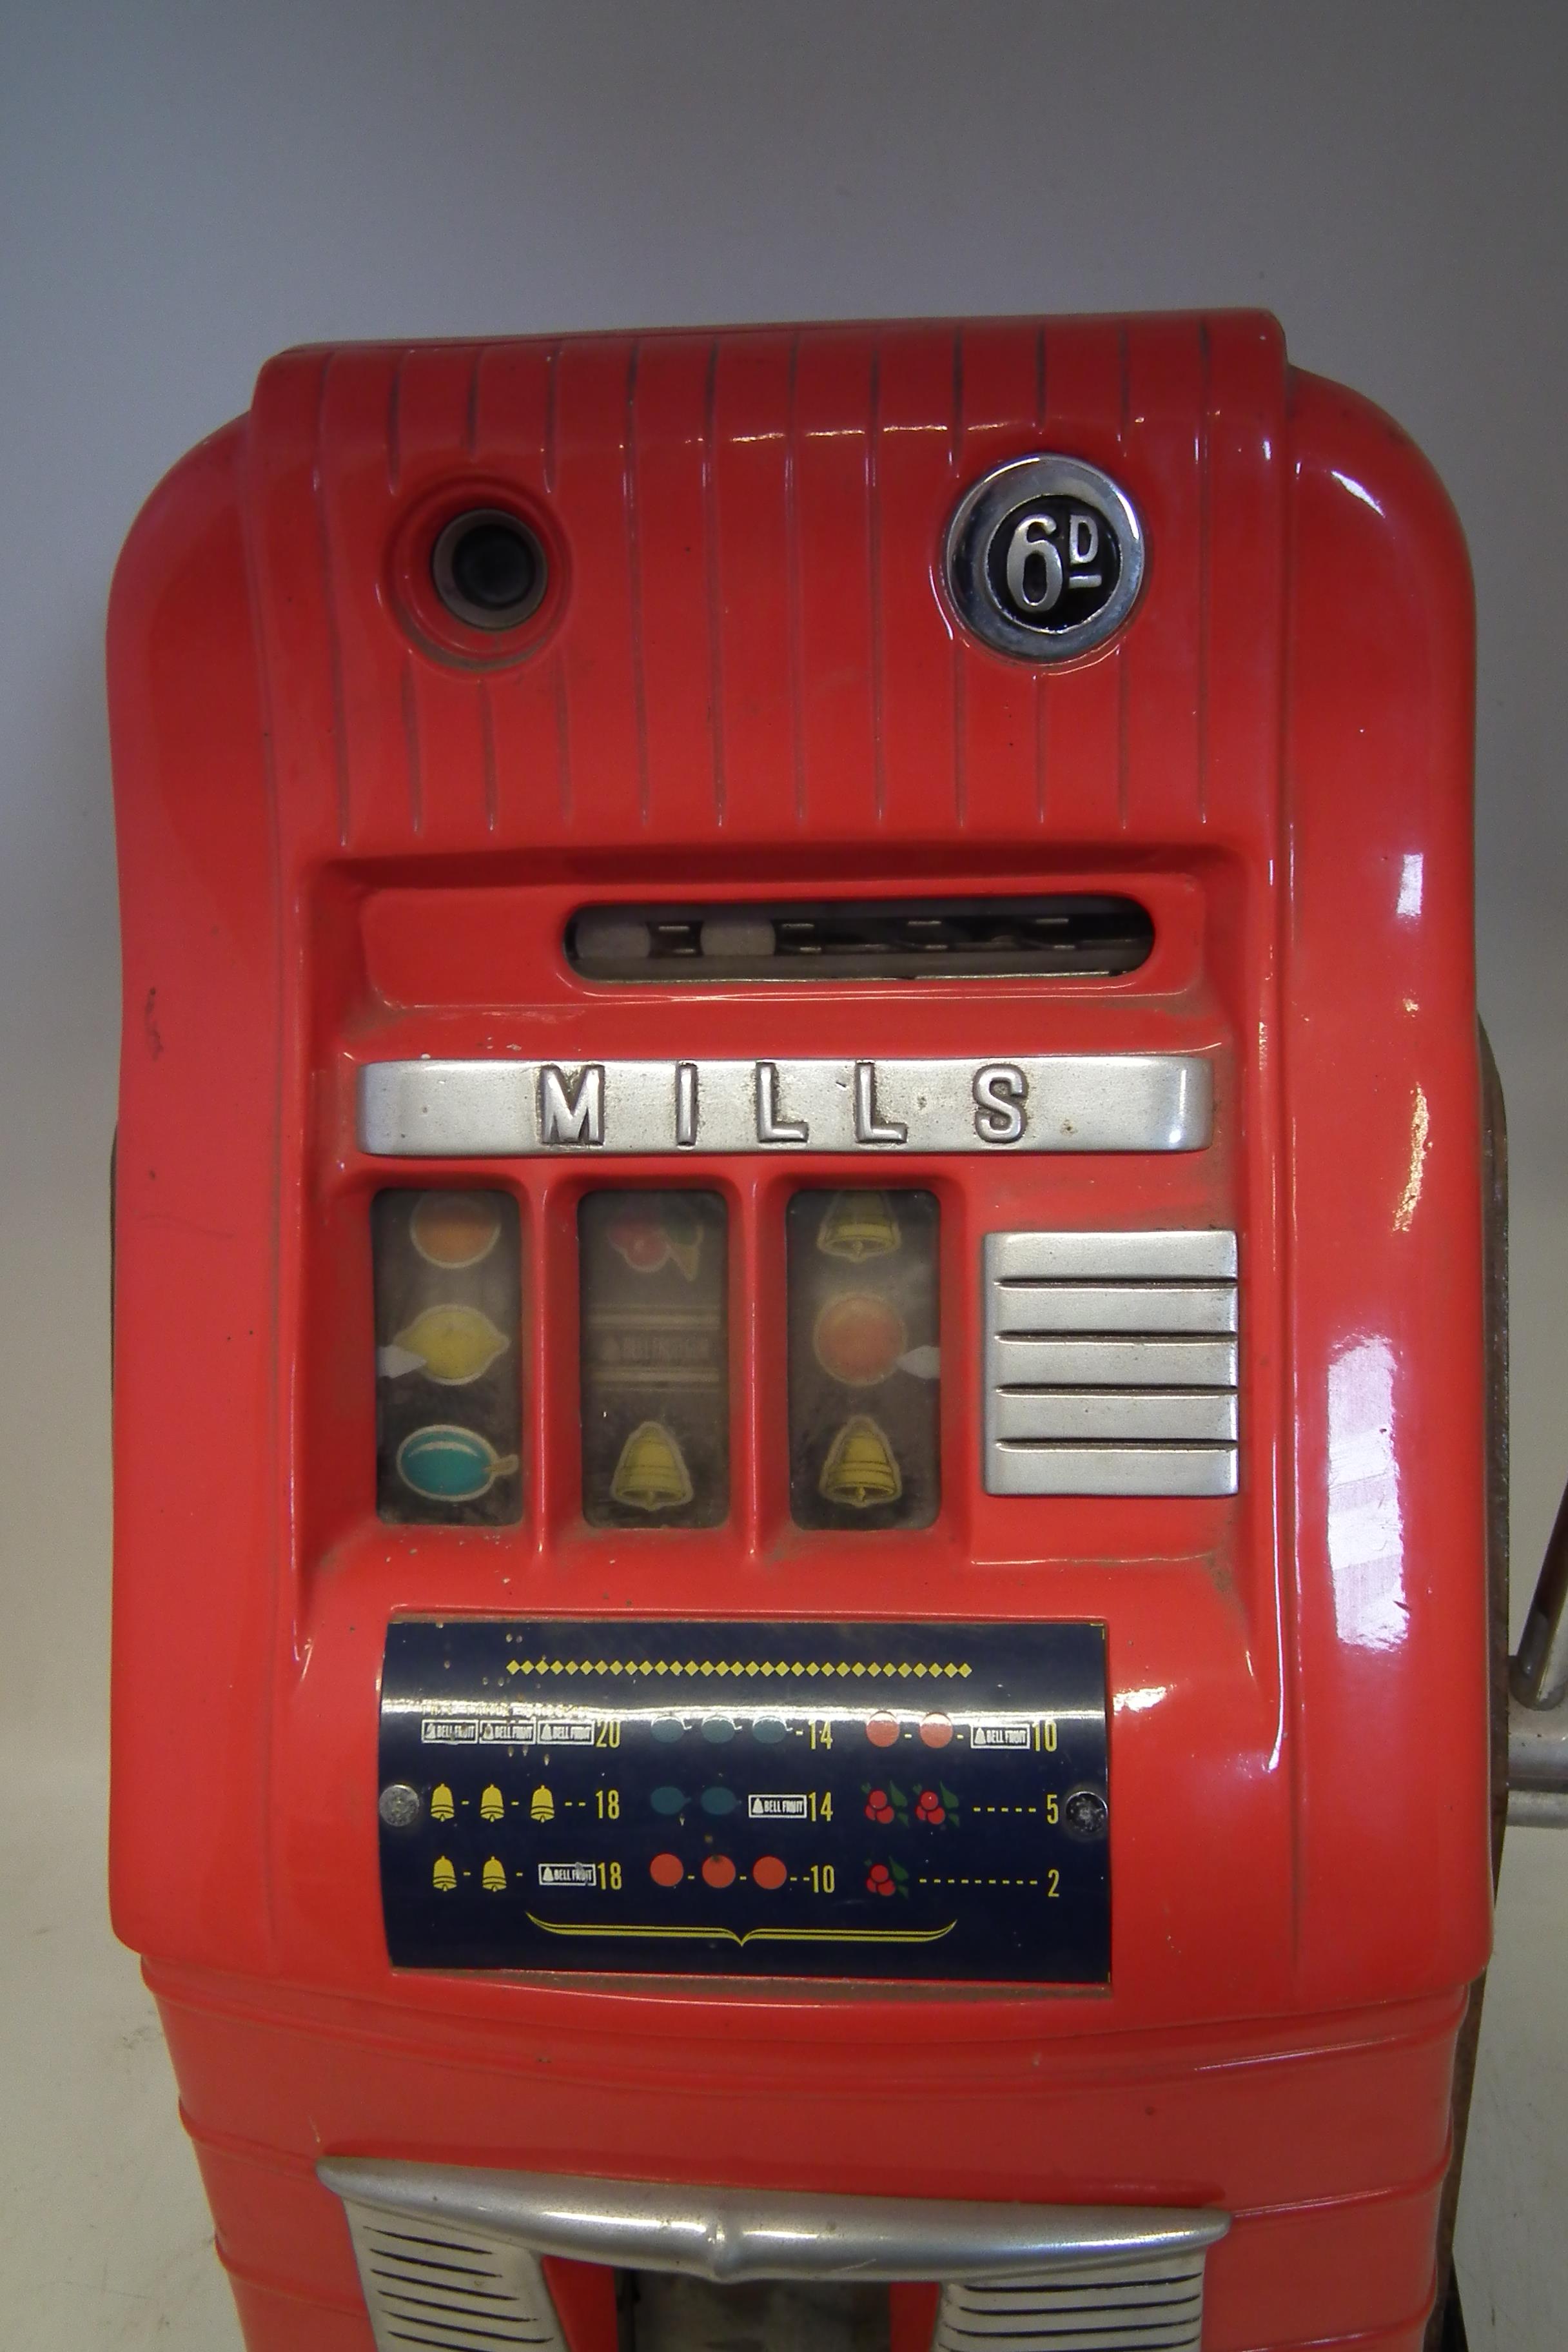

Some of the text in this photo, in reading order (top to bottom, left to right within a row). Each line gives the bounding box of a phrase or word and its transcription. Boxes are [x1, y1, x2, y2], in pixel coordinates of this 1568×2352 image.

[539, 1063, 1028, 1144] MILLS
[595, 1718, 620, 1749] 20
[808, 1720, 832, 1749] 14
[986, 1730, 1003, 1743] BELL
[1032, 1720, 1057, 1752] 10
[596, 1789, 620, 1819] 18
[764, 1800, 803, 1813] BELL FRUIT
[808, 1792, 833, 1821] 14
[1047, 1795, 1058, 1824] 5
[554, 1869, 571, 1881] BELL
[598, 1862, 622, 1890] 18
[811, 1865, 834, 1893] 10
[1048, 1869, 1059, 1897] 2
